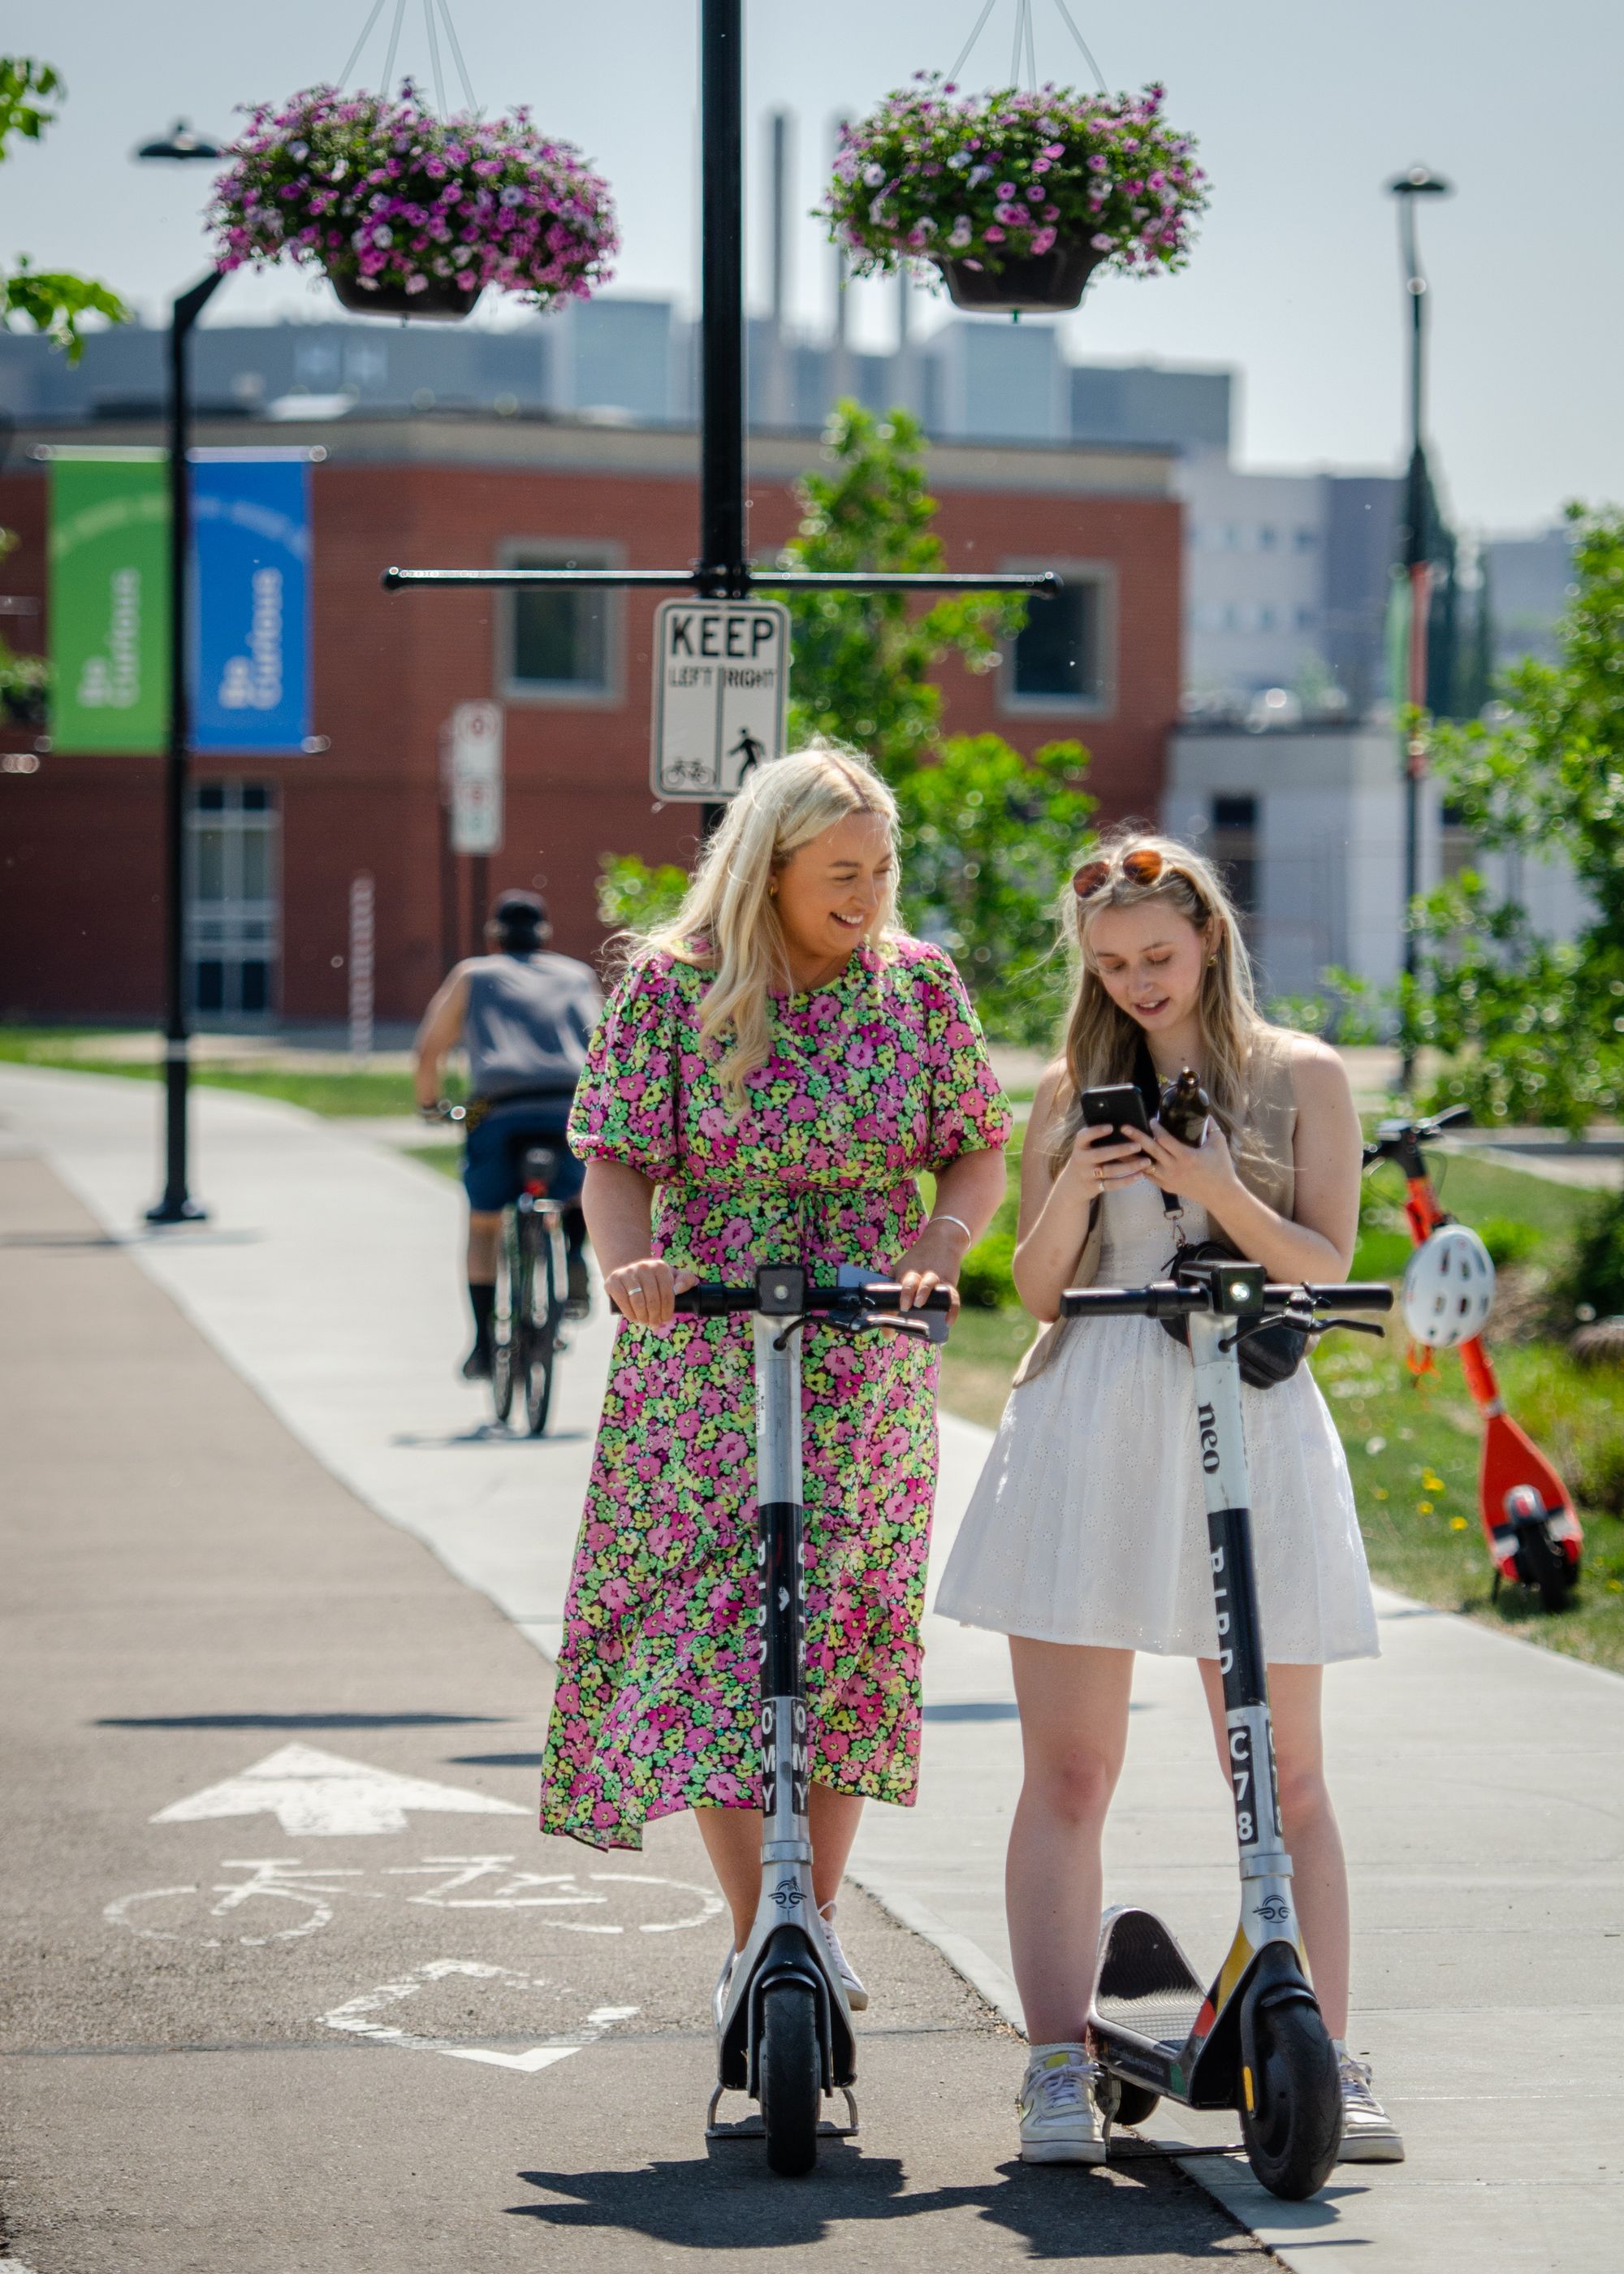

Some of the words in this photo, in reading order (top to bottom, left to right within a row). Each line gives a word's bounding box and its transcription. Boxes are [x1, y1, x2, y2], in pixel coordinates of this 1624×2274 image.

[671, 616, 775, 658] KEEP
[668, 666, 713, 688] LEFT
[728, 668, 775, 688] RIGHT
[1229, 1731, 1253, 1840] C78
